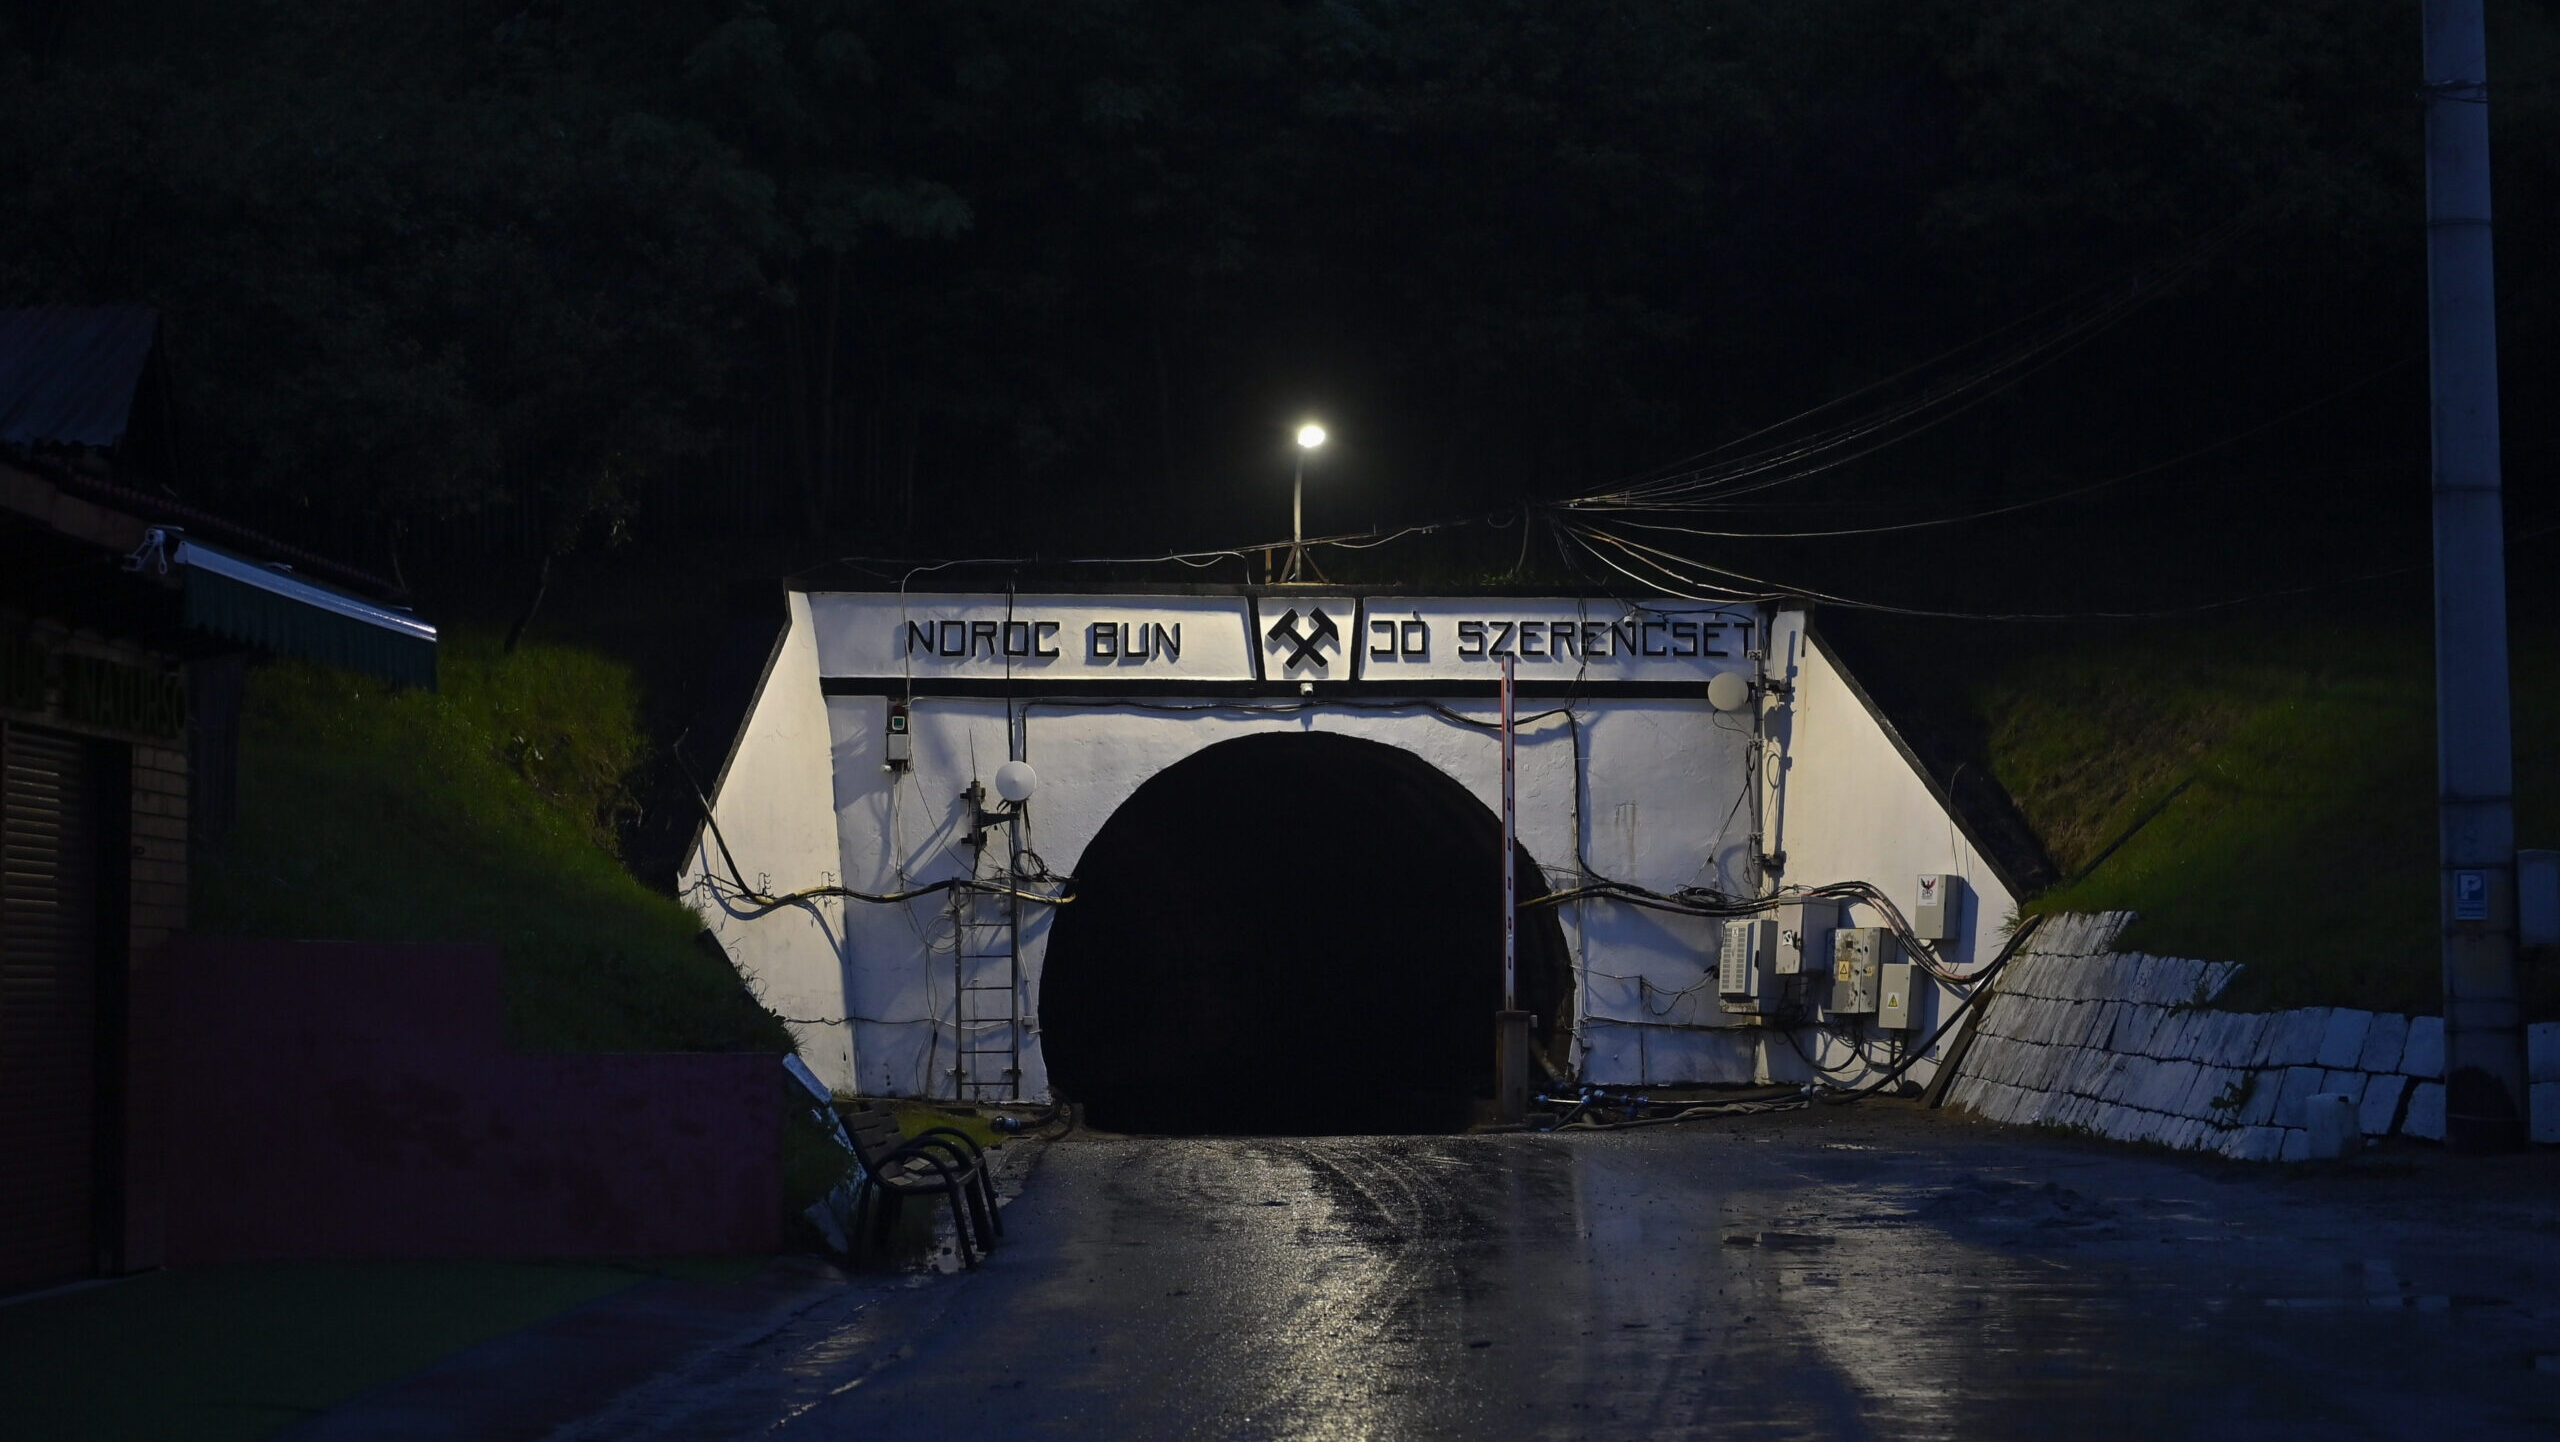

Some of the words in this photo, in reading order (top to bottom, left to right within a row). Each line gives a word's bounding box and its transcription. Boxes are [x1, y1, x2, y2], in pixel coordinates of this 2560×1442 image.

[908, 620, 1060, 657] NOROC
[1093, 621, 1181, 658] BUN
[2459, 874, 2483, 900] P
